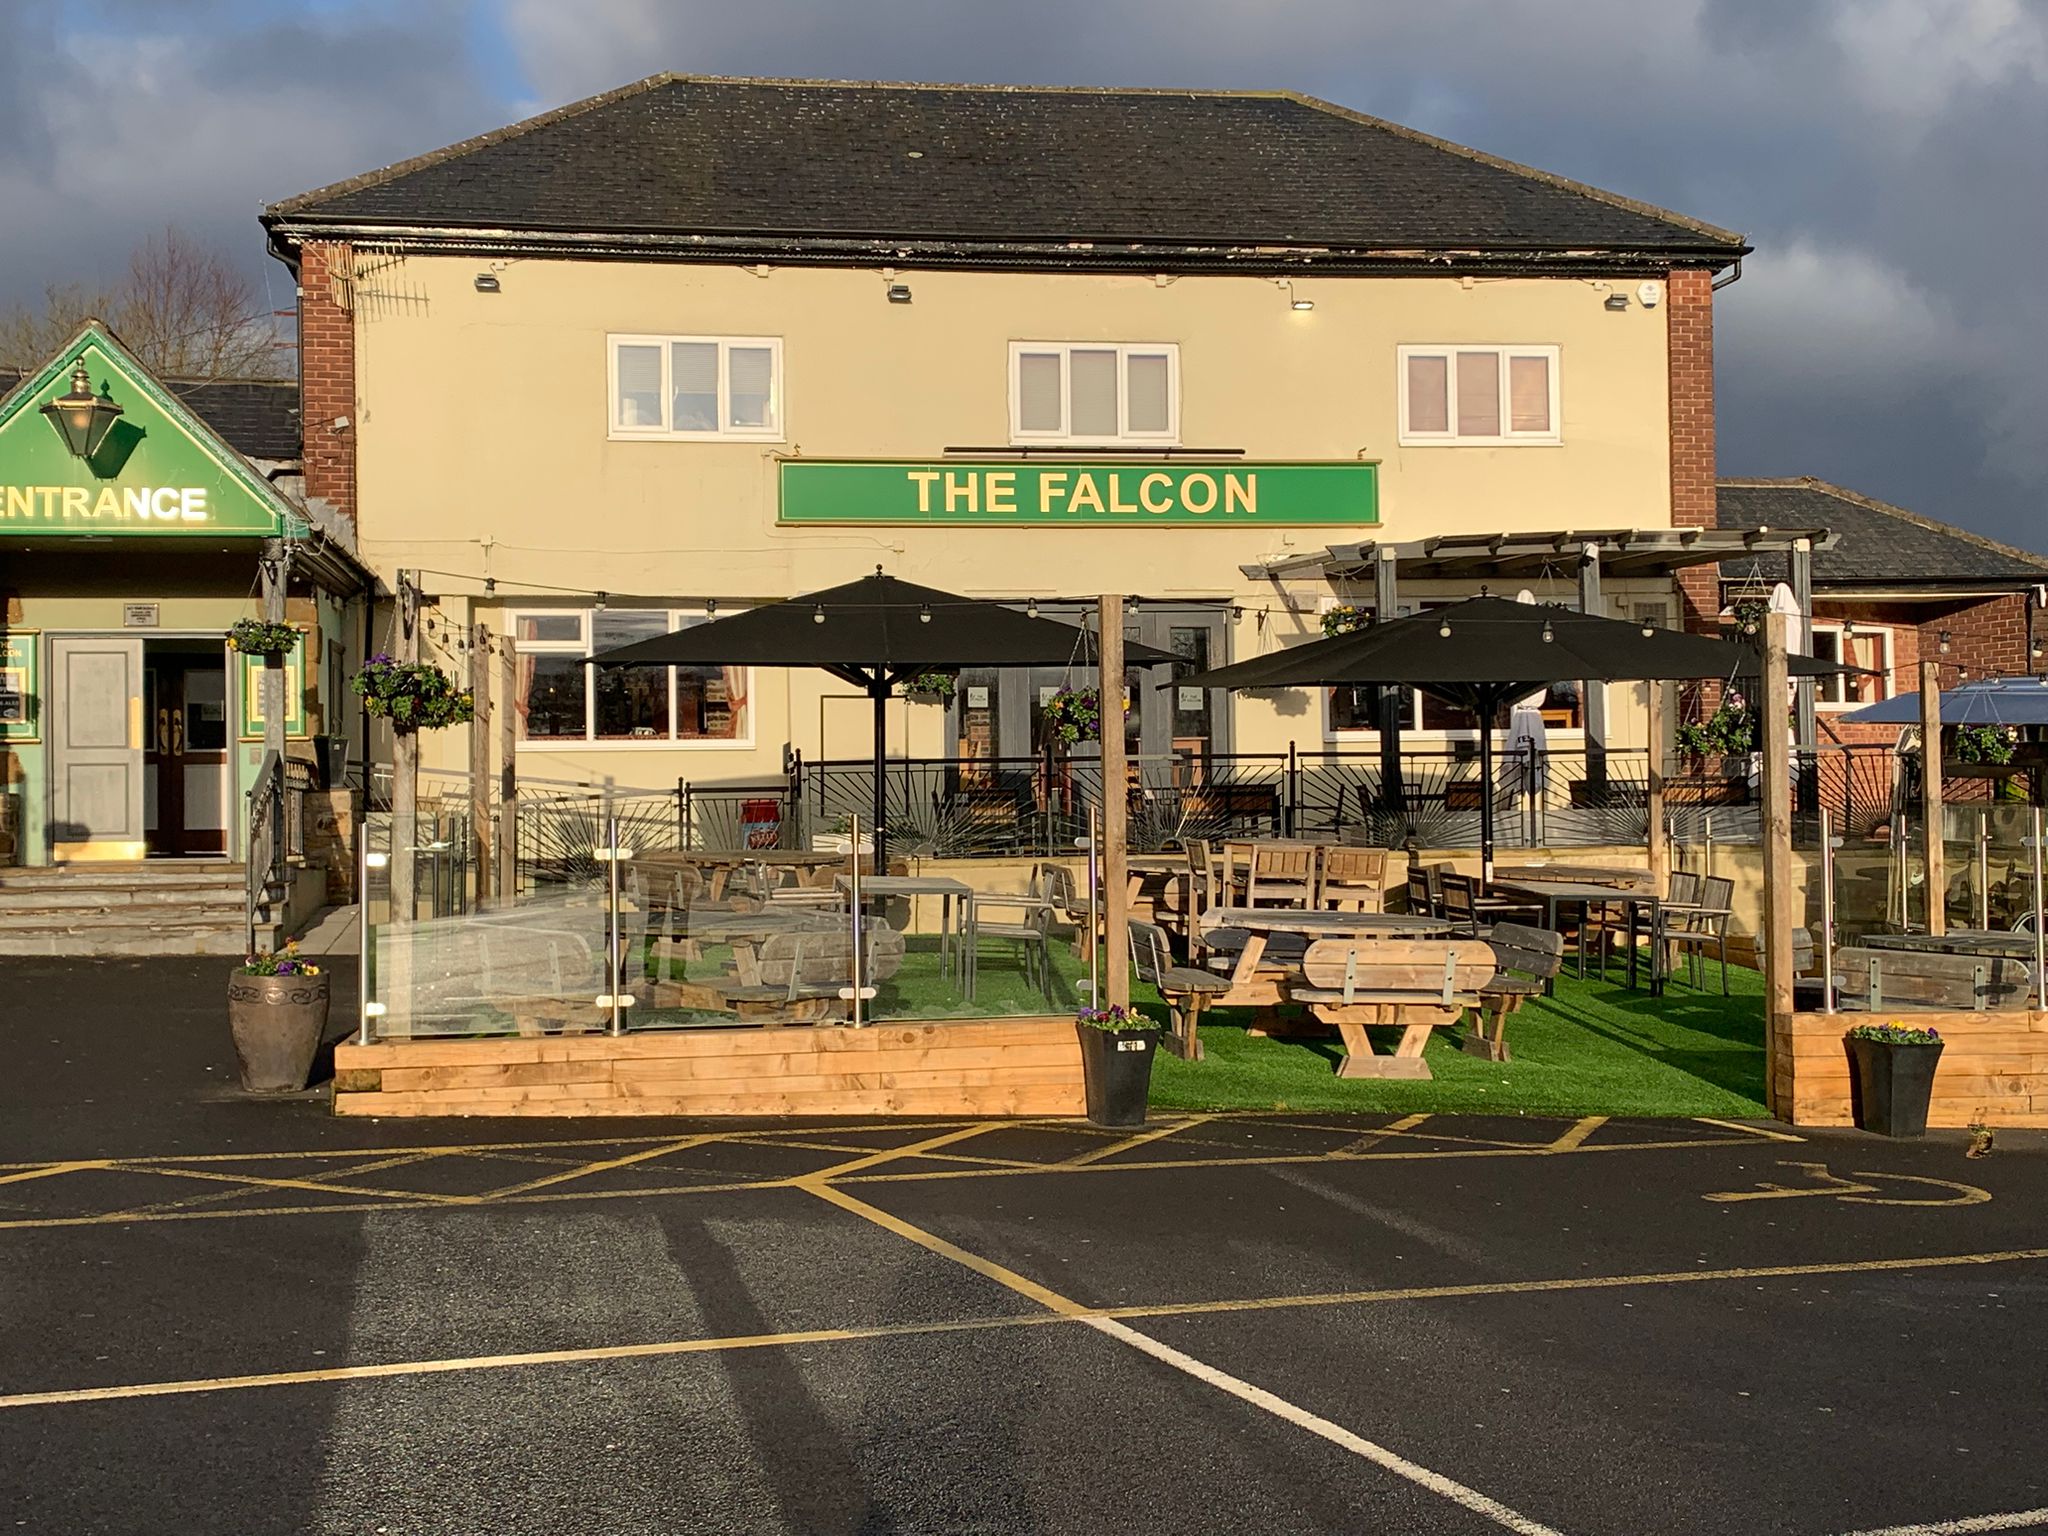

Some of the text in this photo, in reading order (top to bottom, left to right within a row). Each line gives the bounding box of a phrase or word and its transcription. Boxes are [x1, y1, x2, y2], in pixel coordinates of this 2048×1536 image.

[0, 485, 208, 521] NTRANCE
[907, 471, 1257, 514] THE FALCON
